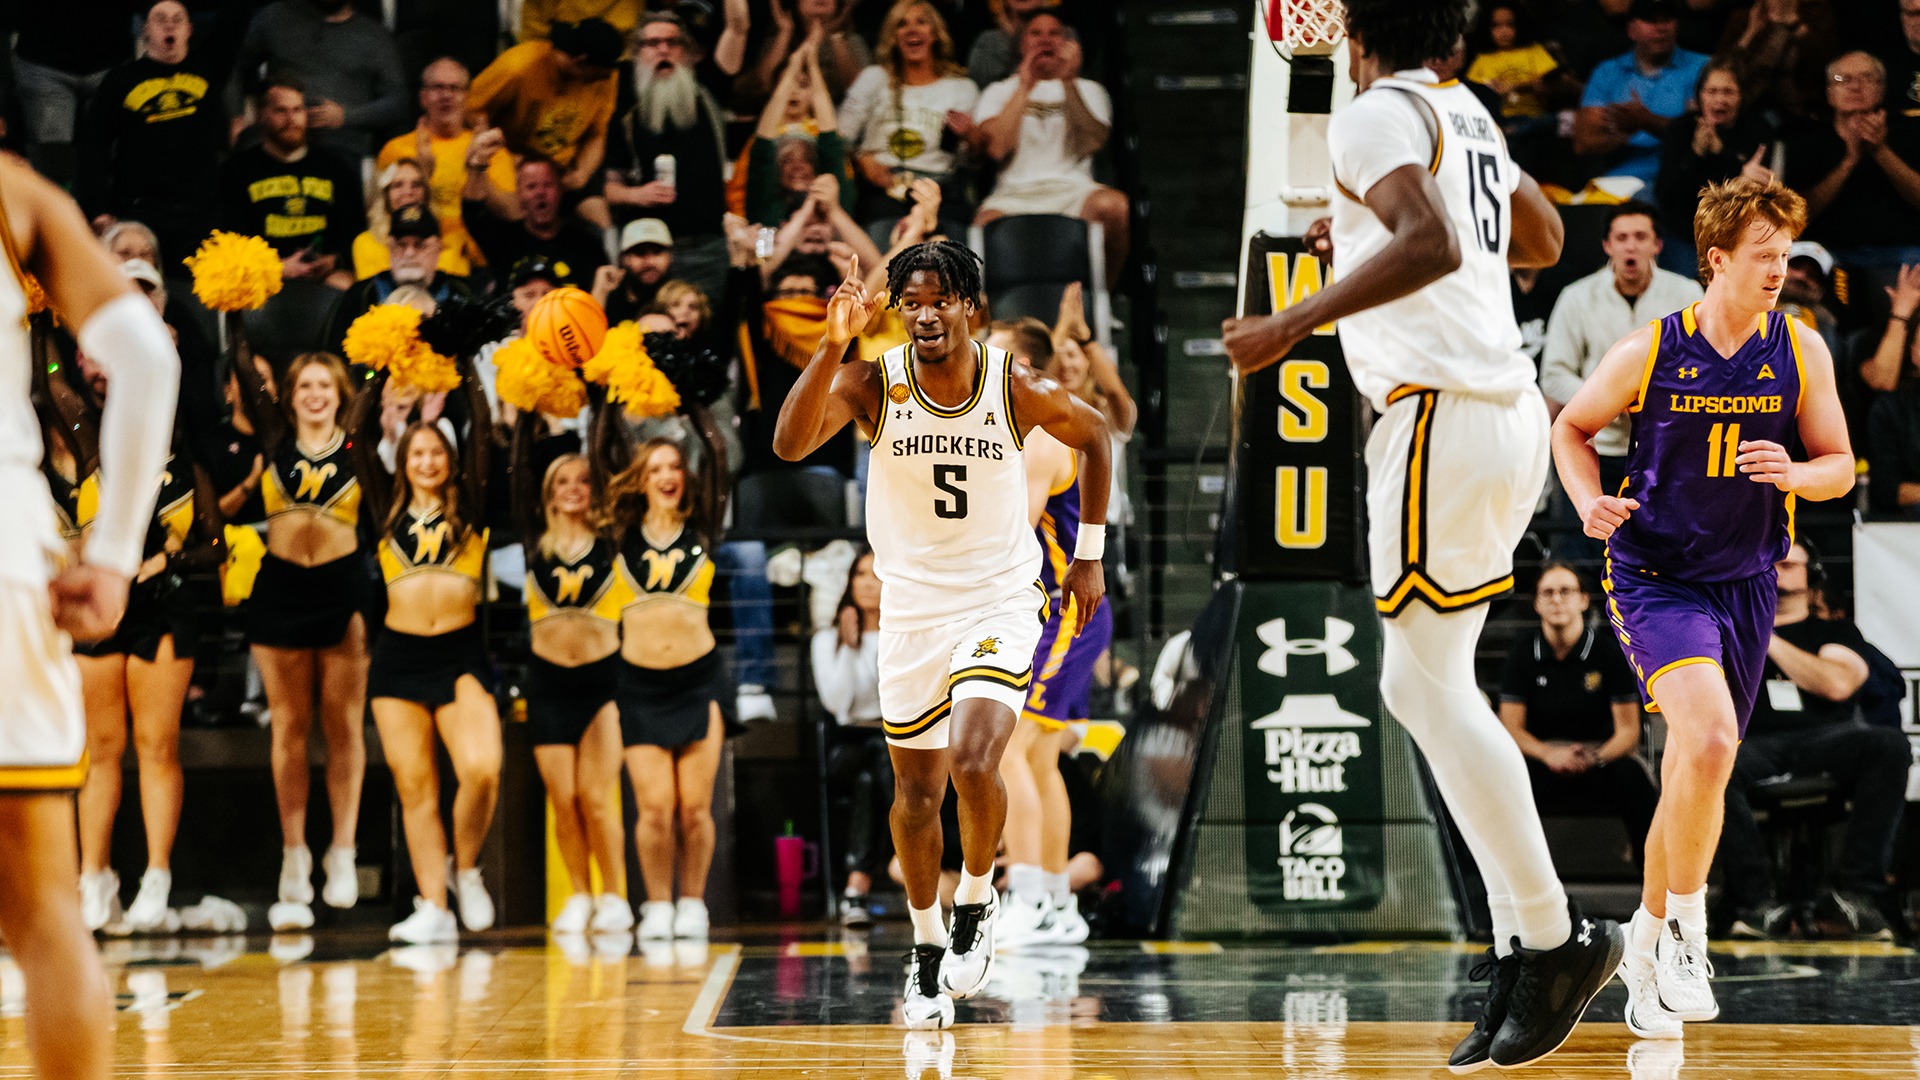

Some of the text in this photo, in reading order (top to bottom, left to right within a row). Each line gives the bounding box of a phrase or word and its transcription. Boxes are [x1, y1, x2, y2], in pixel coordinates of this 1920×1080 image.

[1466, 149, 1501, 254] 15
[1670, 394, 1782, 414] LIPSCOMB
[893, 434, 1003, 461] SHOCKERS
[1706, 422, 1741, 478] 11
[933, 463, 968, 519] 5
[1026, 682, 1047, 711] L
[1265, 727, 1361, 765] Pizza
[1267, 757, 1348, 793] Hut
[1277, 856, 1346, 880] TACO
[1283, 877, 1346, 901] BELL
